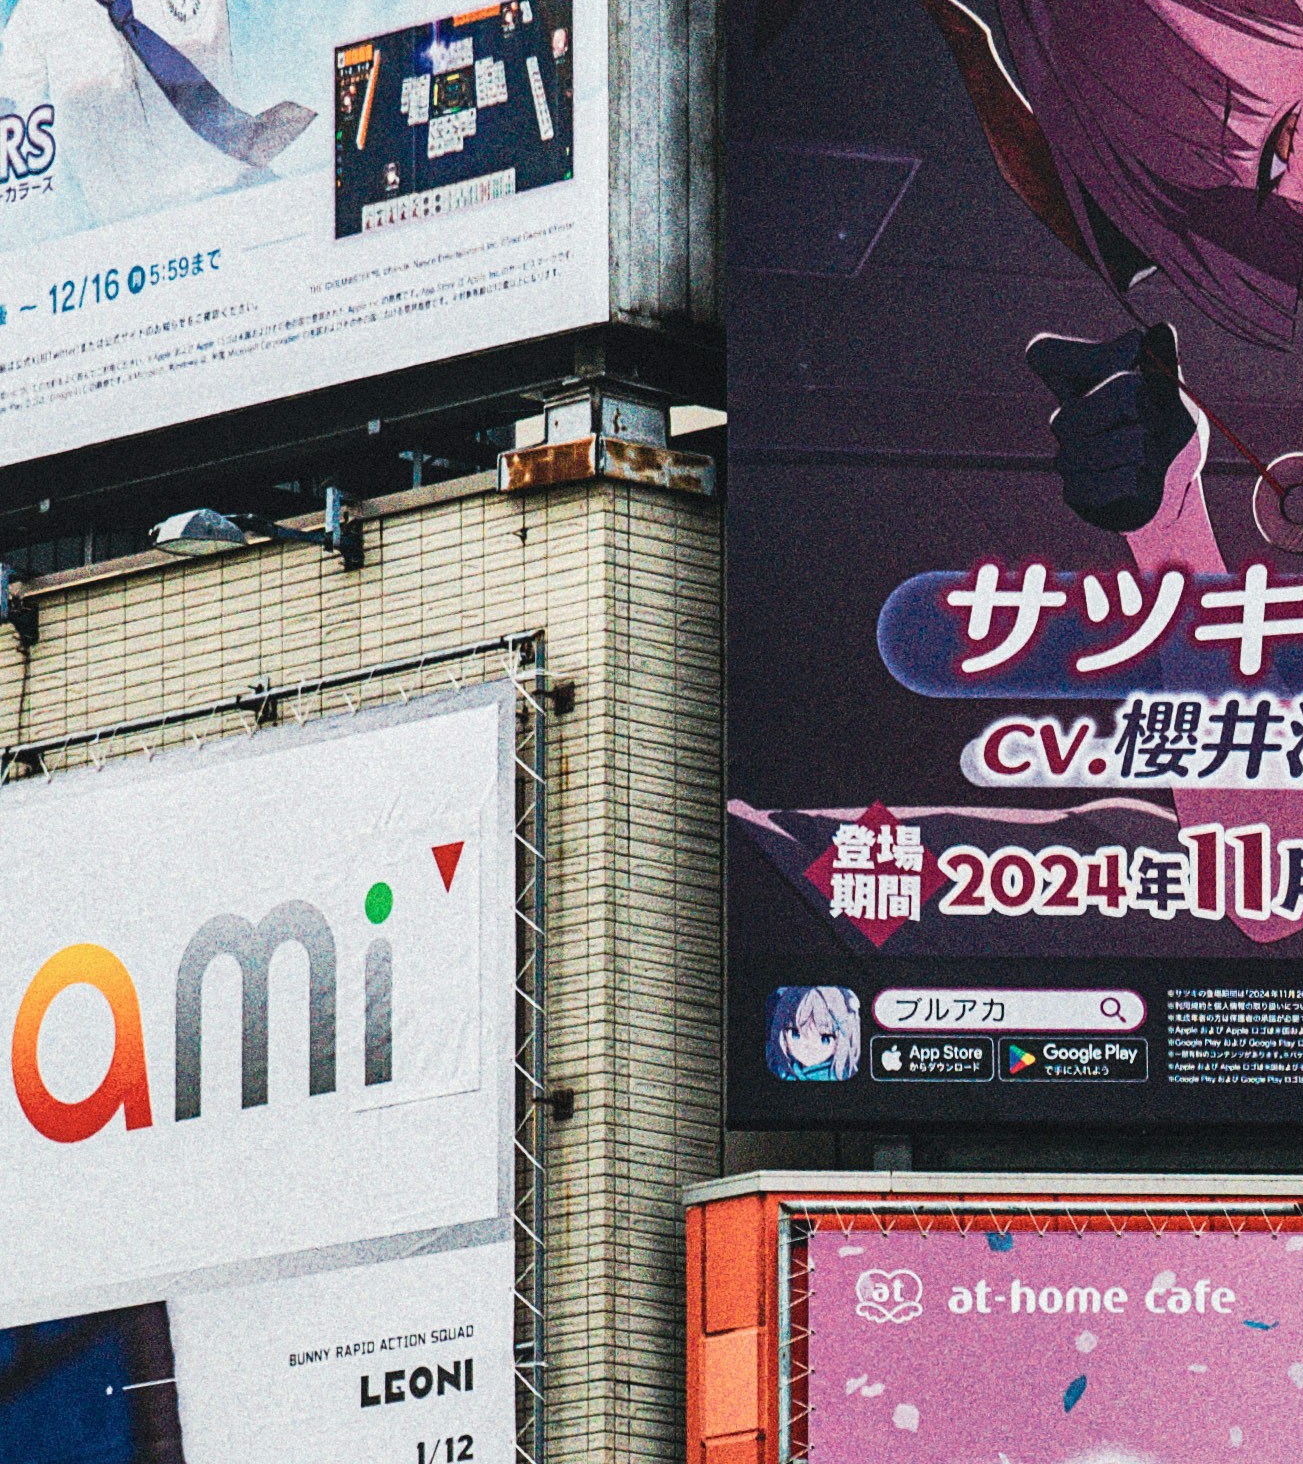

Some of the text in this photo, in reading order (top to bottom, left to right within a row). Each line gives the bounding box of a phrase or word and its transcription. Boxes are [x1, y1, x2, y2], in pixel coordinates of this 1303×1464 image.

[49, 269, 120, 315] 12/16
[830, 824, 925, 871] 登場
[829, 874, 922, 922] 期間
[895, 996, 1006, 1023] ブルアカ
[909, 1044, 983, 1062] App Store
[1043, 1042, 1138, 1064] Google Play
[946, 1276, 1237, 1315] at-home cafe
[289, 1324, 474, 1368] BUNNY RAPID ACTION SQUAD
